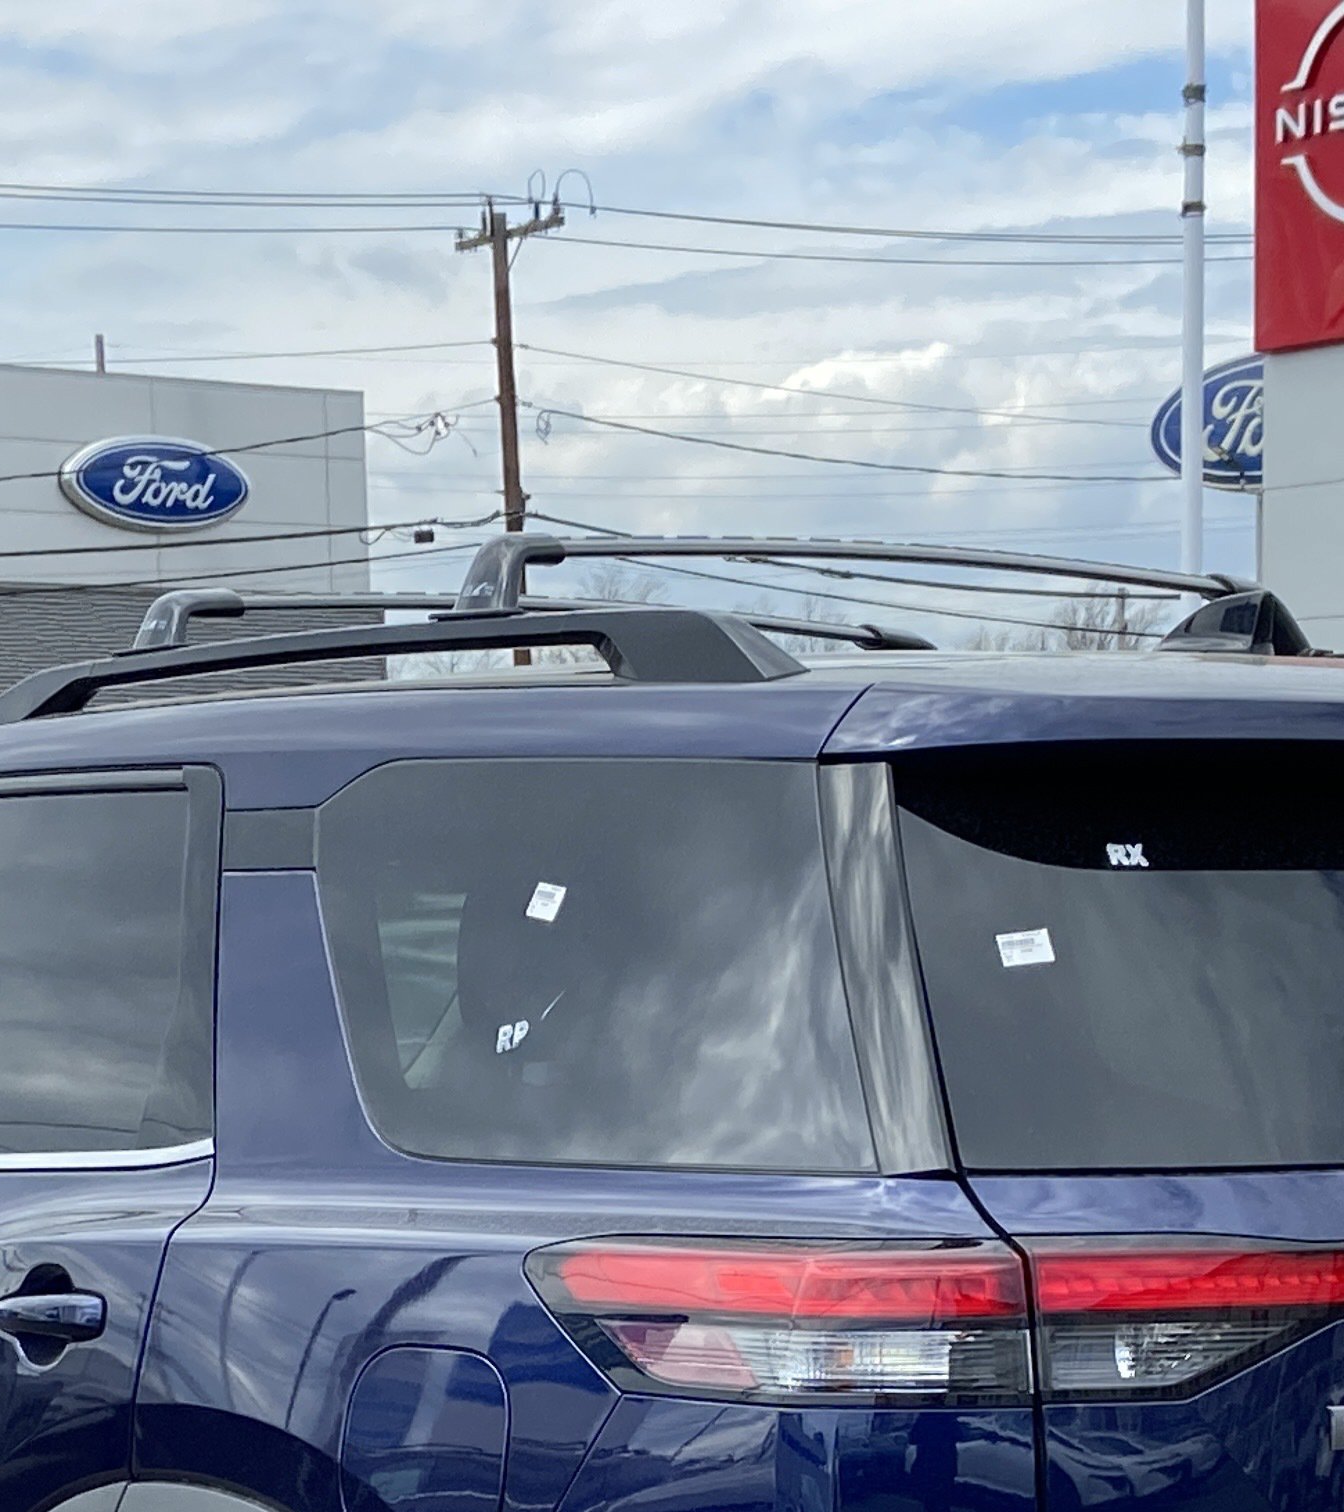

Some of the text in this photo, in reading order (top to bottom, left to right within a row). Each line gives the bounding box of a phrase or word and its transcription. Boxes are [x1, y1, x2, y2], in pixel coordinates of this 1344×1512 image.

[1200, 378, 1264, 462] Fo
[113, 456, 217, 511] Ford
[1106, 842, 1150, 868] RX
[495, 1019, 530, 1054] RP
